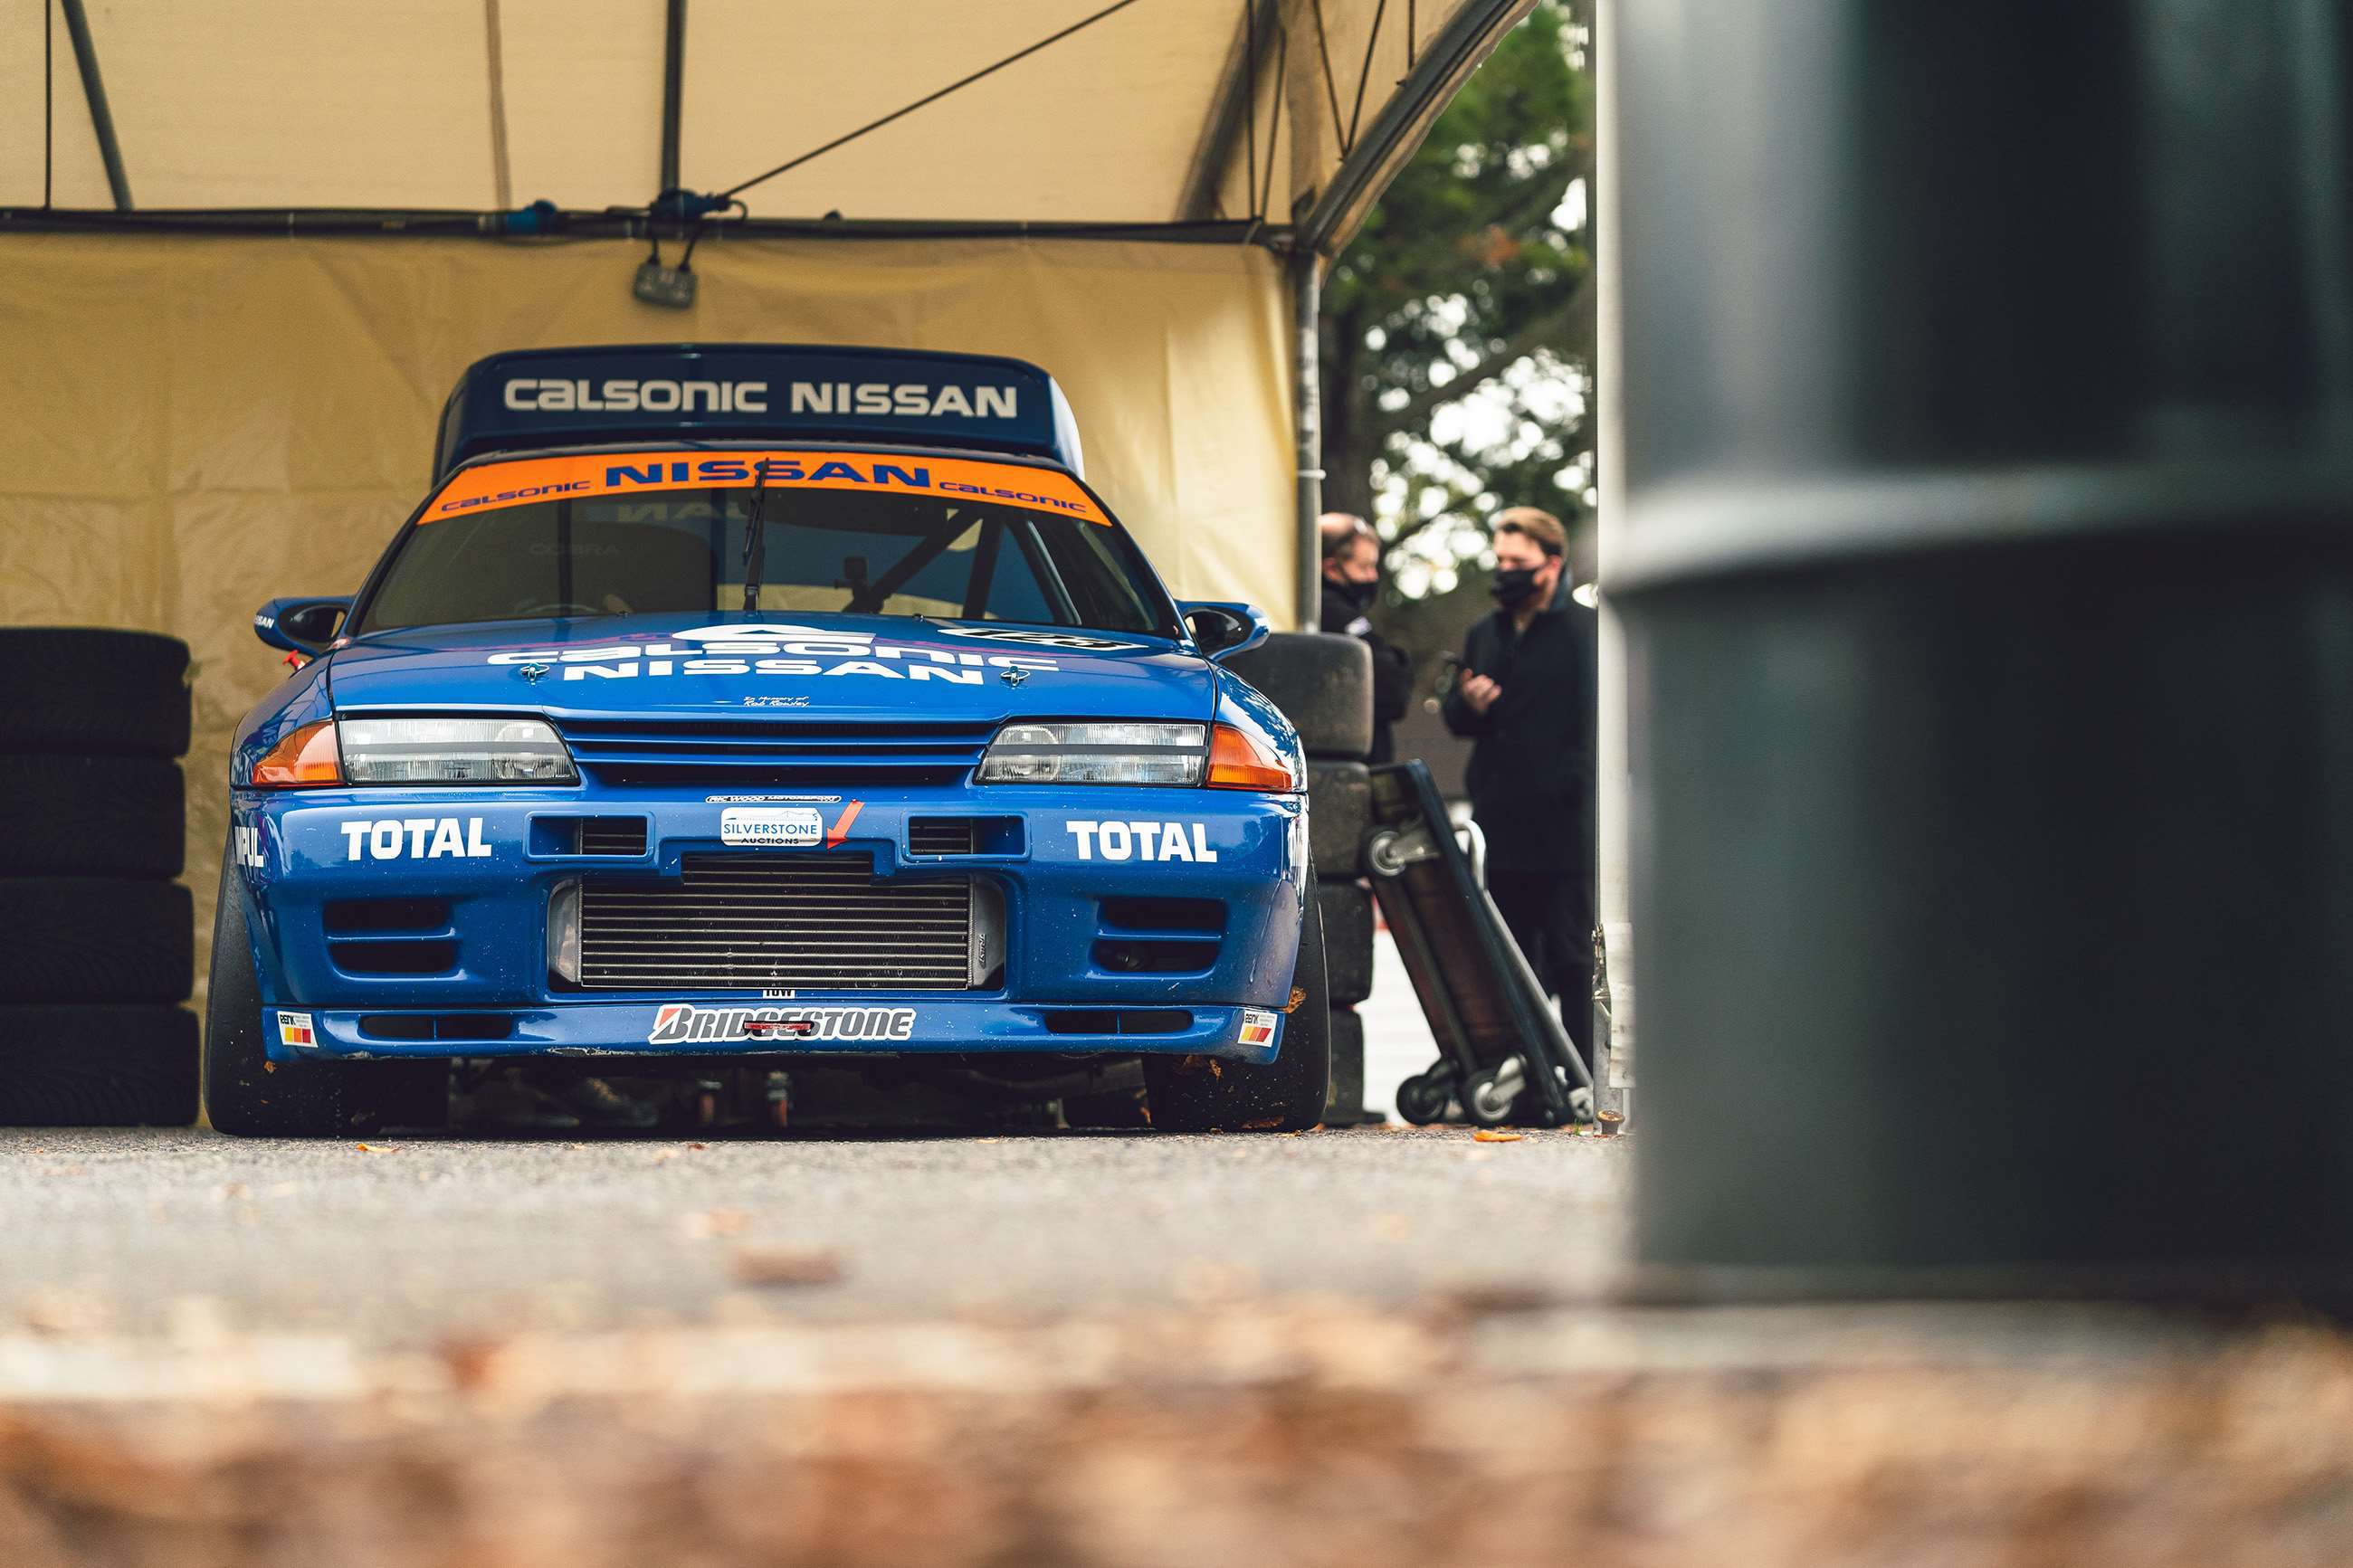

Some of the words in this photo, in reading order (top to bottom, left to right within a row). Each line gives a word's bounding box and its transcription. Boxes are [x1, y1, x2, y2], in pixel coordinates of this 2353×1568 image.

[790, 382, 1017, 419] NISSAN
[605, 459, 932, 489] NISSAN
[563, 659, 985, 686] NISSAN
[340, 817, 492, 861] TOTAL
[723, 823, 818, 835] SILVERSTONE
[1065, 821, 1218, 863] TOTAL
[649, 1005, 915, 1043] BRIDGESTONE
